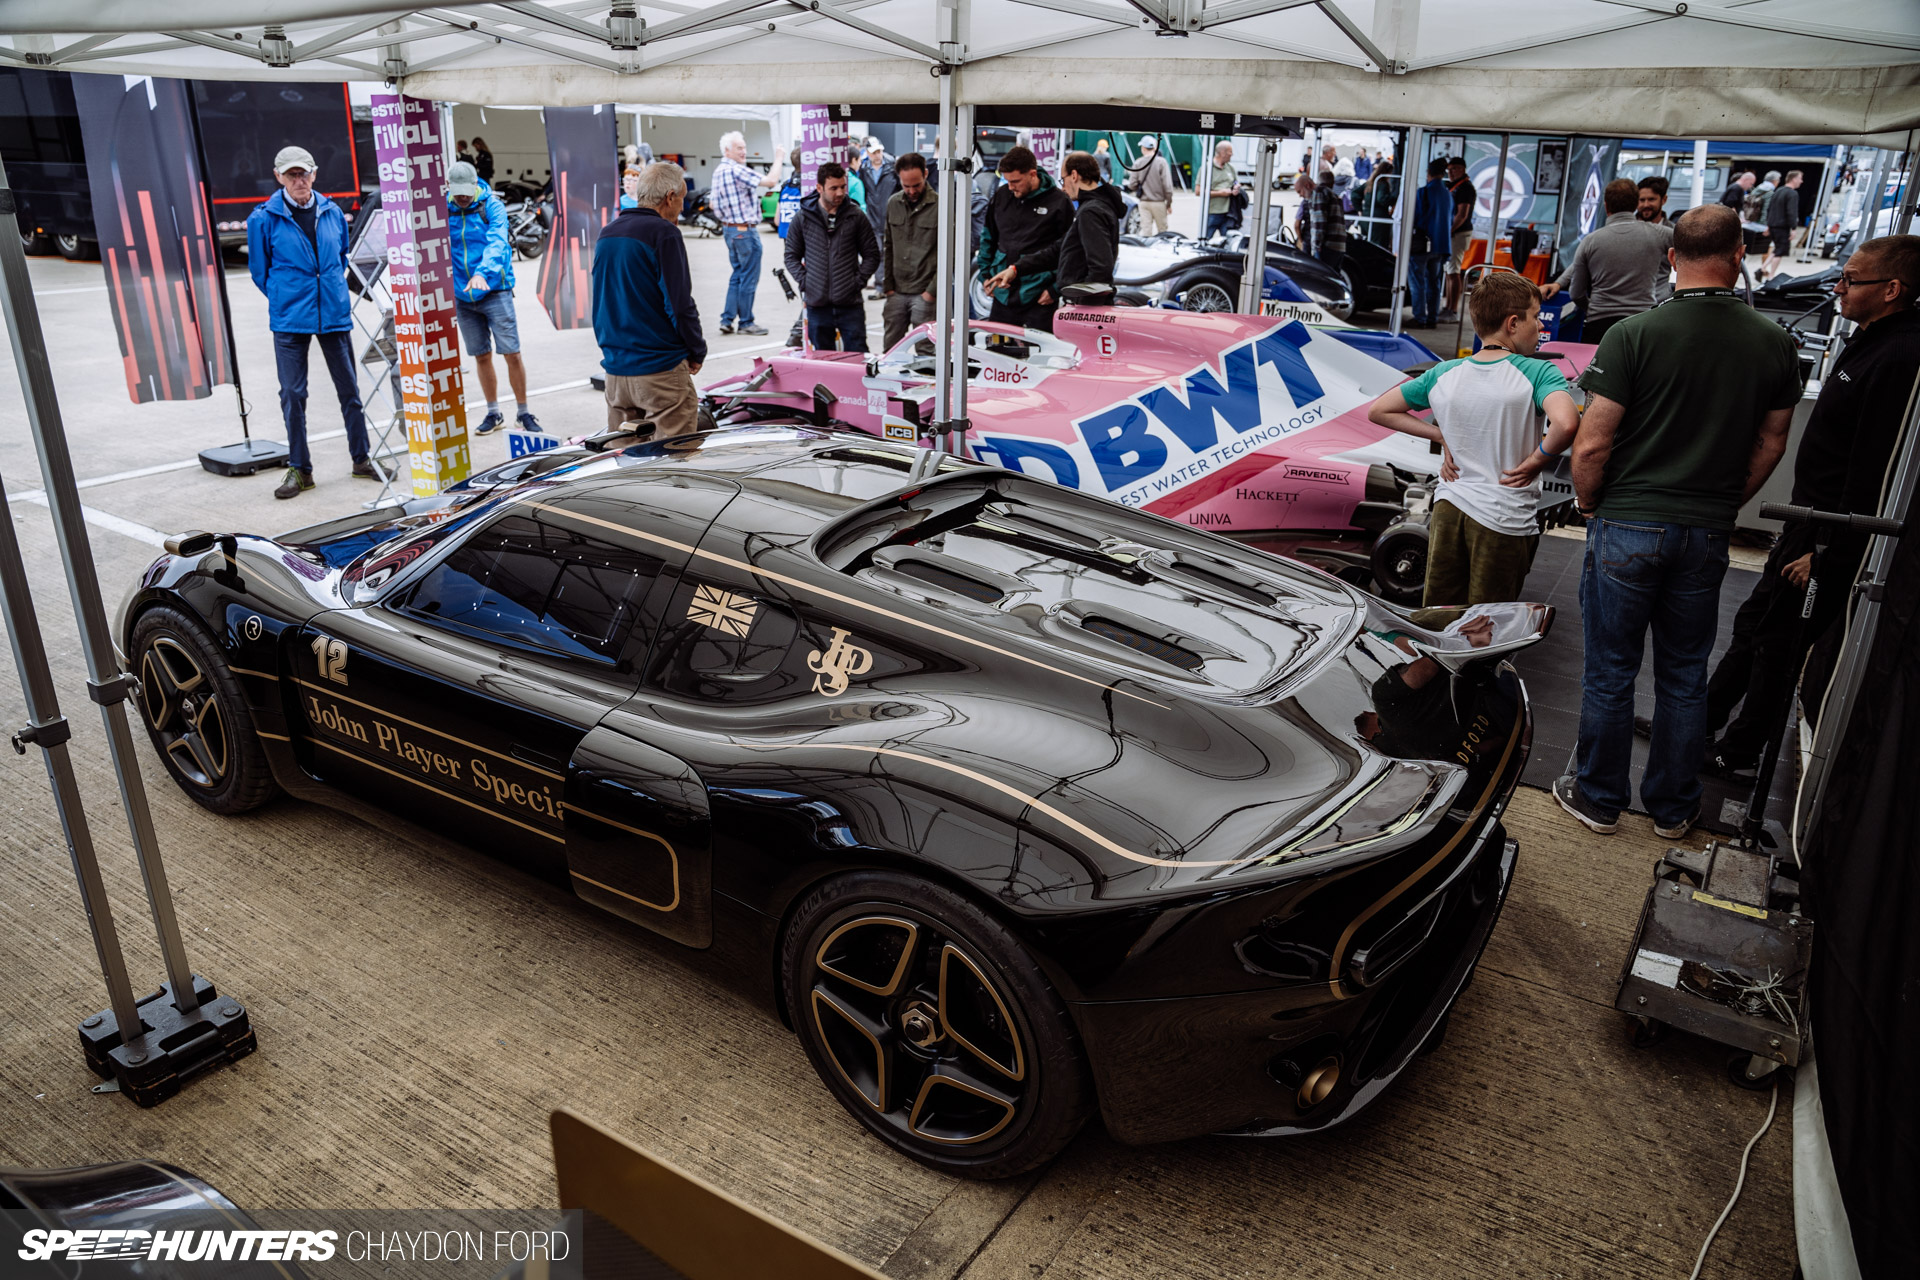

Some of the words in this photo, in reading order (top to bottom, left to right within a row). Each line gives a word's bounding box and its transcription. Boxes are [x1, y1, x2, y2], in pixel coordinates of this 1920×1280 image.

[1058, 312, 1116, 324] BOMBARDIER
[1265, 303, 1322, 323] Marlboro
[1101, 336, 1112, 355] E
[984, 366, 1022, 384] Claro
[838, 396, 867, 406] canada
[1078, 320, 1325, 493] BWT
[887, 427, 913, 438] JCB
[1114, 486, 1149, 507] EST
[1152, 459, 1210, 492] WATER
[1211, 406, 1324, 464] TECHNOLOGY
[1290, 469, 1344, 481] RAVENOL
[1189, 513, 1231, 525] UNIVA
[311, 634, 349, 686] 12
[309, 696, 369, 743] John
[372, 720, 461, 779] Player
